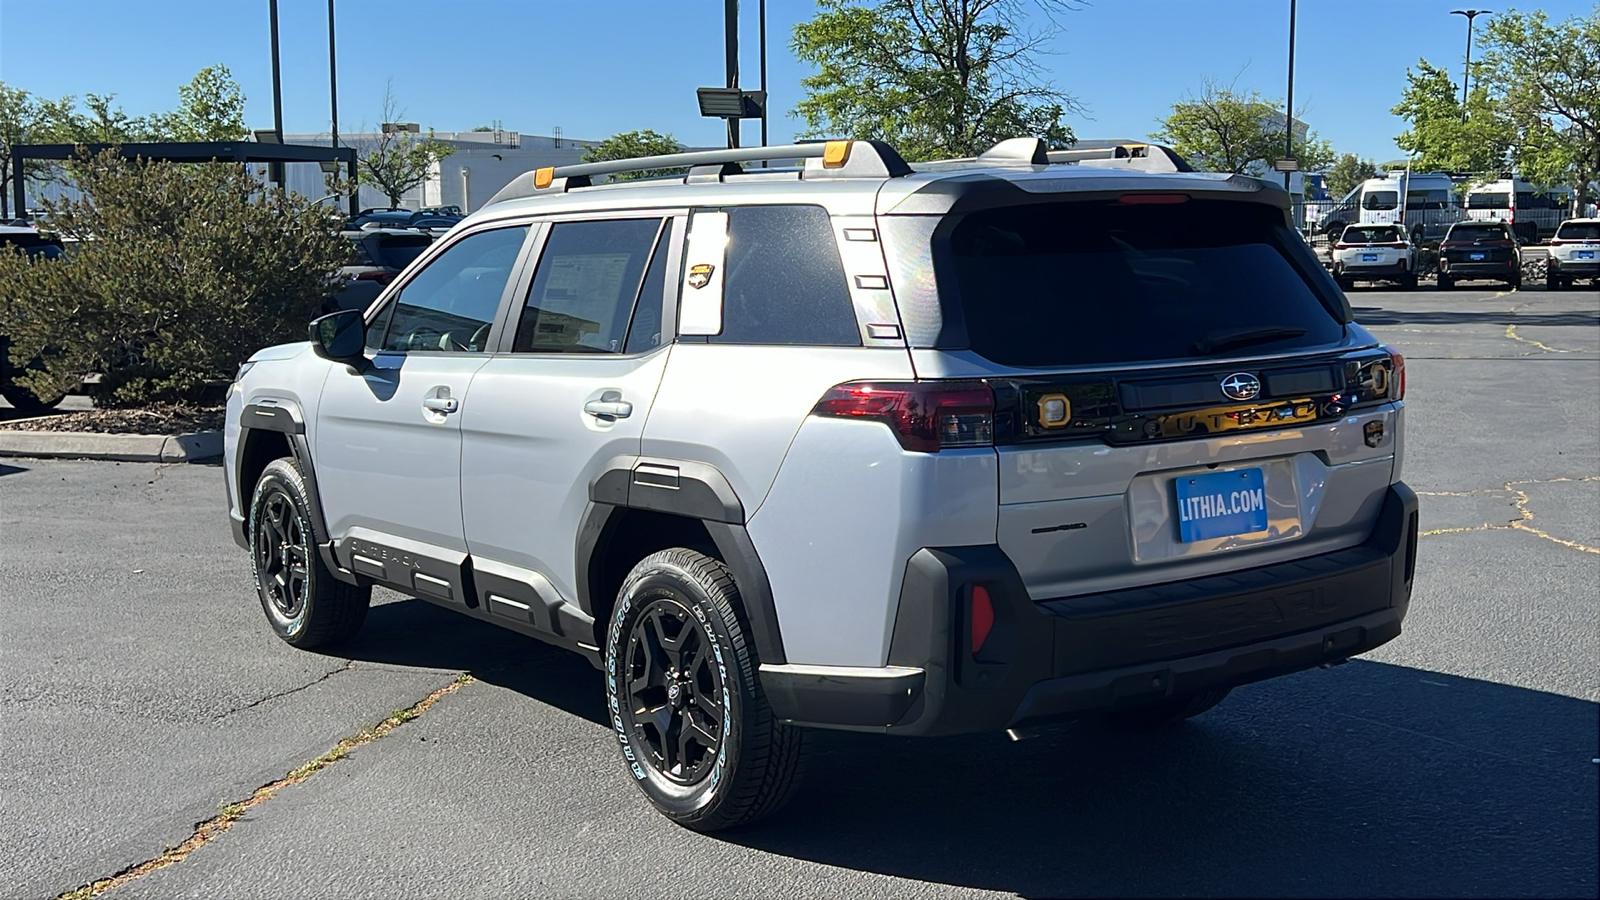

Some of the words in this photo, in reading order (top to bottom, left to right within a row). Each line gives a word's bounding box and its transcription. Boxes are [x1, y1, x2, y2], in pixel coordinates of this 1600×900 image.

[1143, 402, 1331, 434] OUTBACK
[1180, 488, 1264, 522] LITHIA.COM
[351, 541, 420, 569] OUTBACK
[608, 594, 647, 781] BRIDGESTONE
